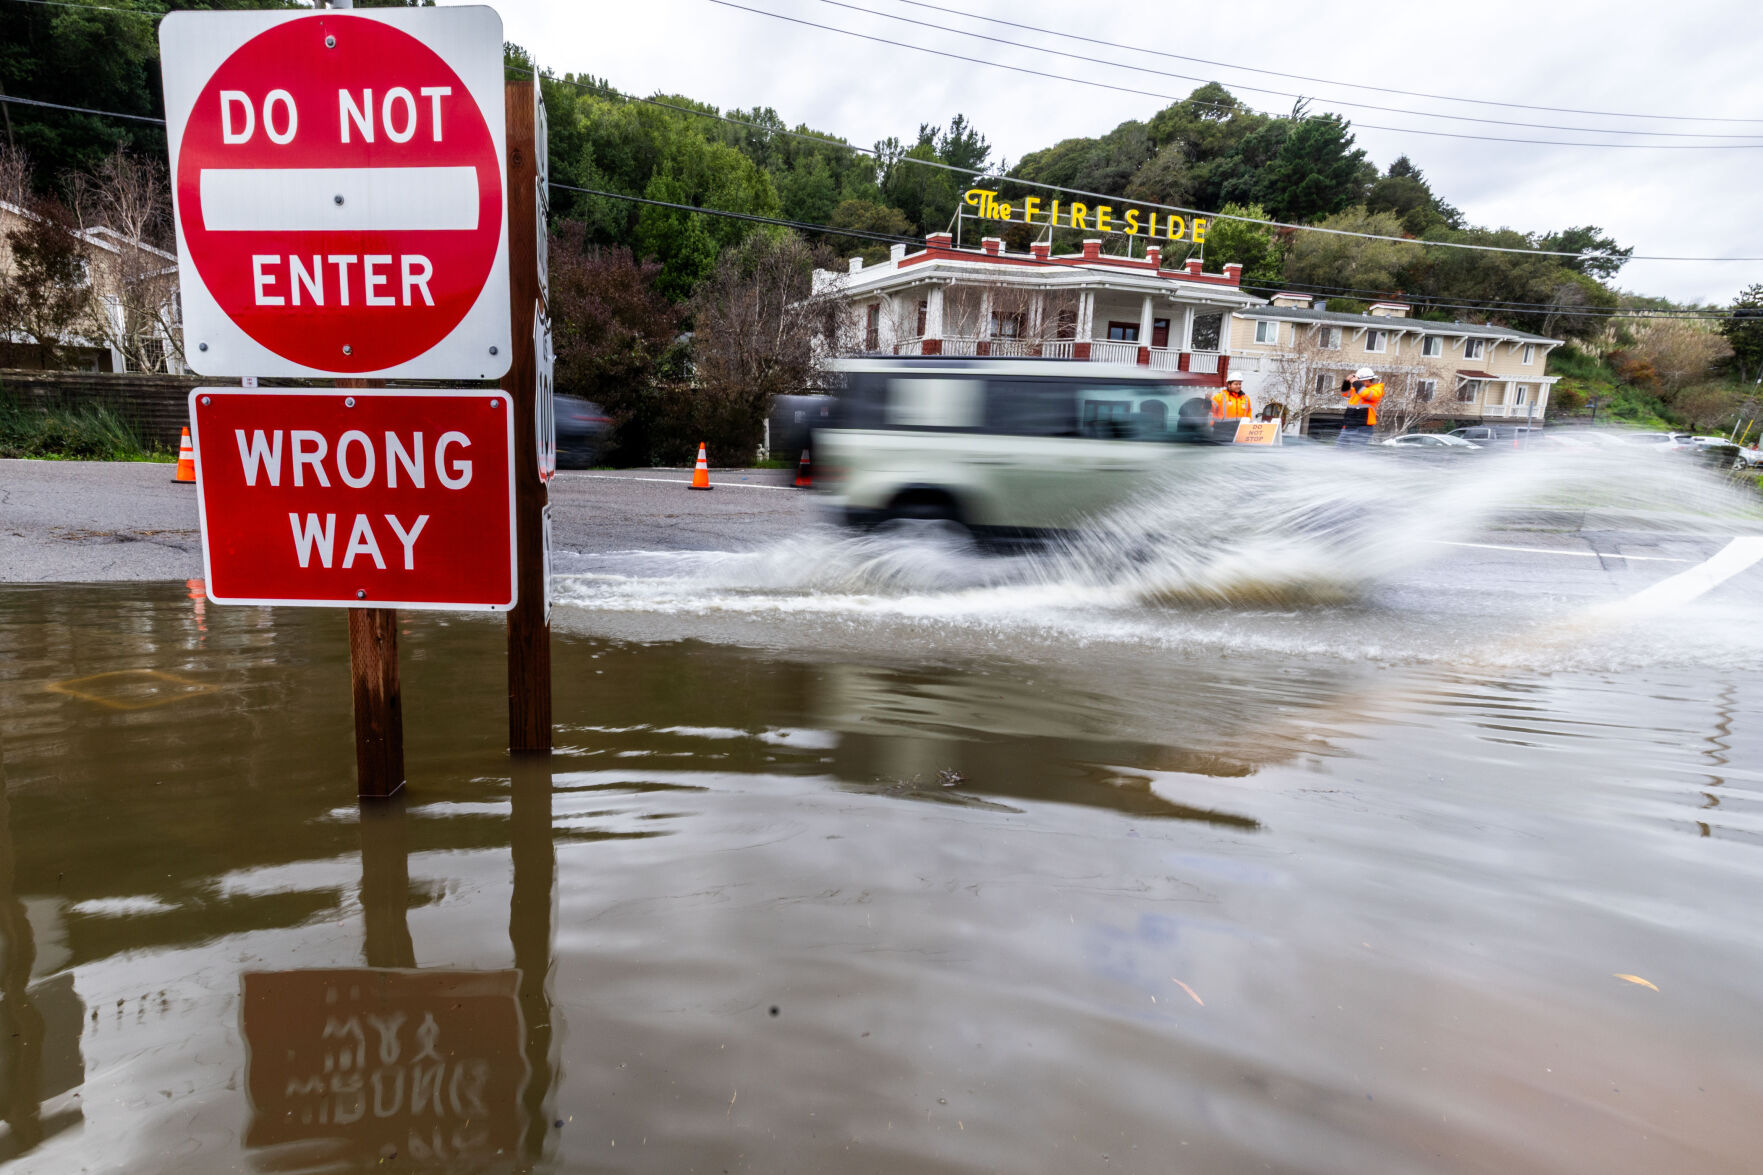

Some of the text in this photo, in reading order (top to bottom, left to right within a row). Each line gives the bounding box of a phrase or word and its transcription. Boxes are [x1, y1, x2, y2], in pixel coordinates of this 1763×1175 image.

[219, 86, 452, 146] DO NOT
[964, 188, 1207, 244] The FIRESIDE
[251, 253, 436, 307] ENTER
[235, 428, 473, 490] WRONG
[289, 511, 431, 571] WAY
